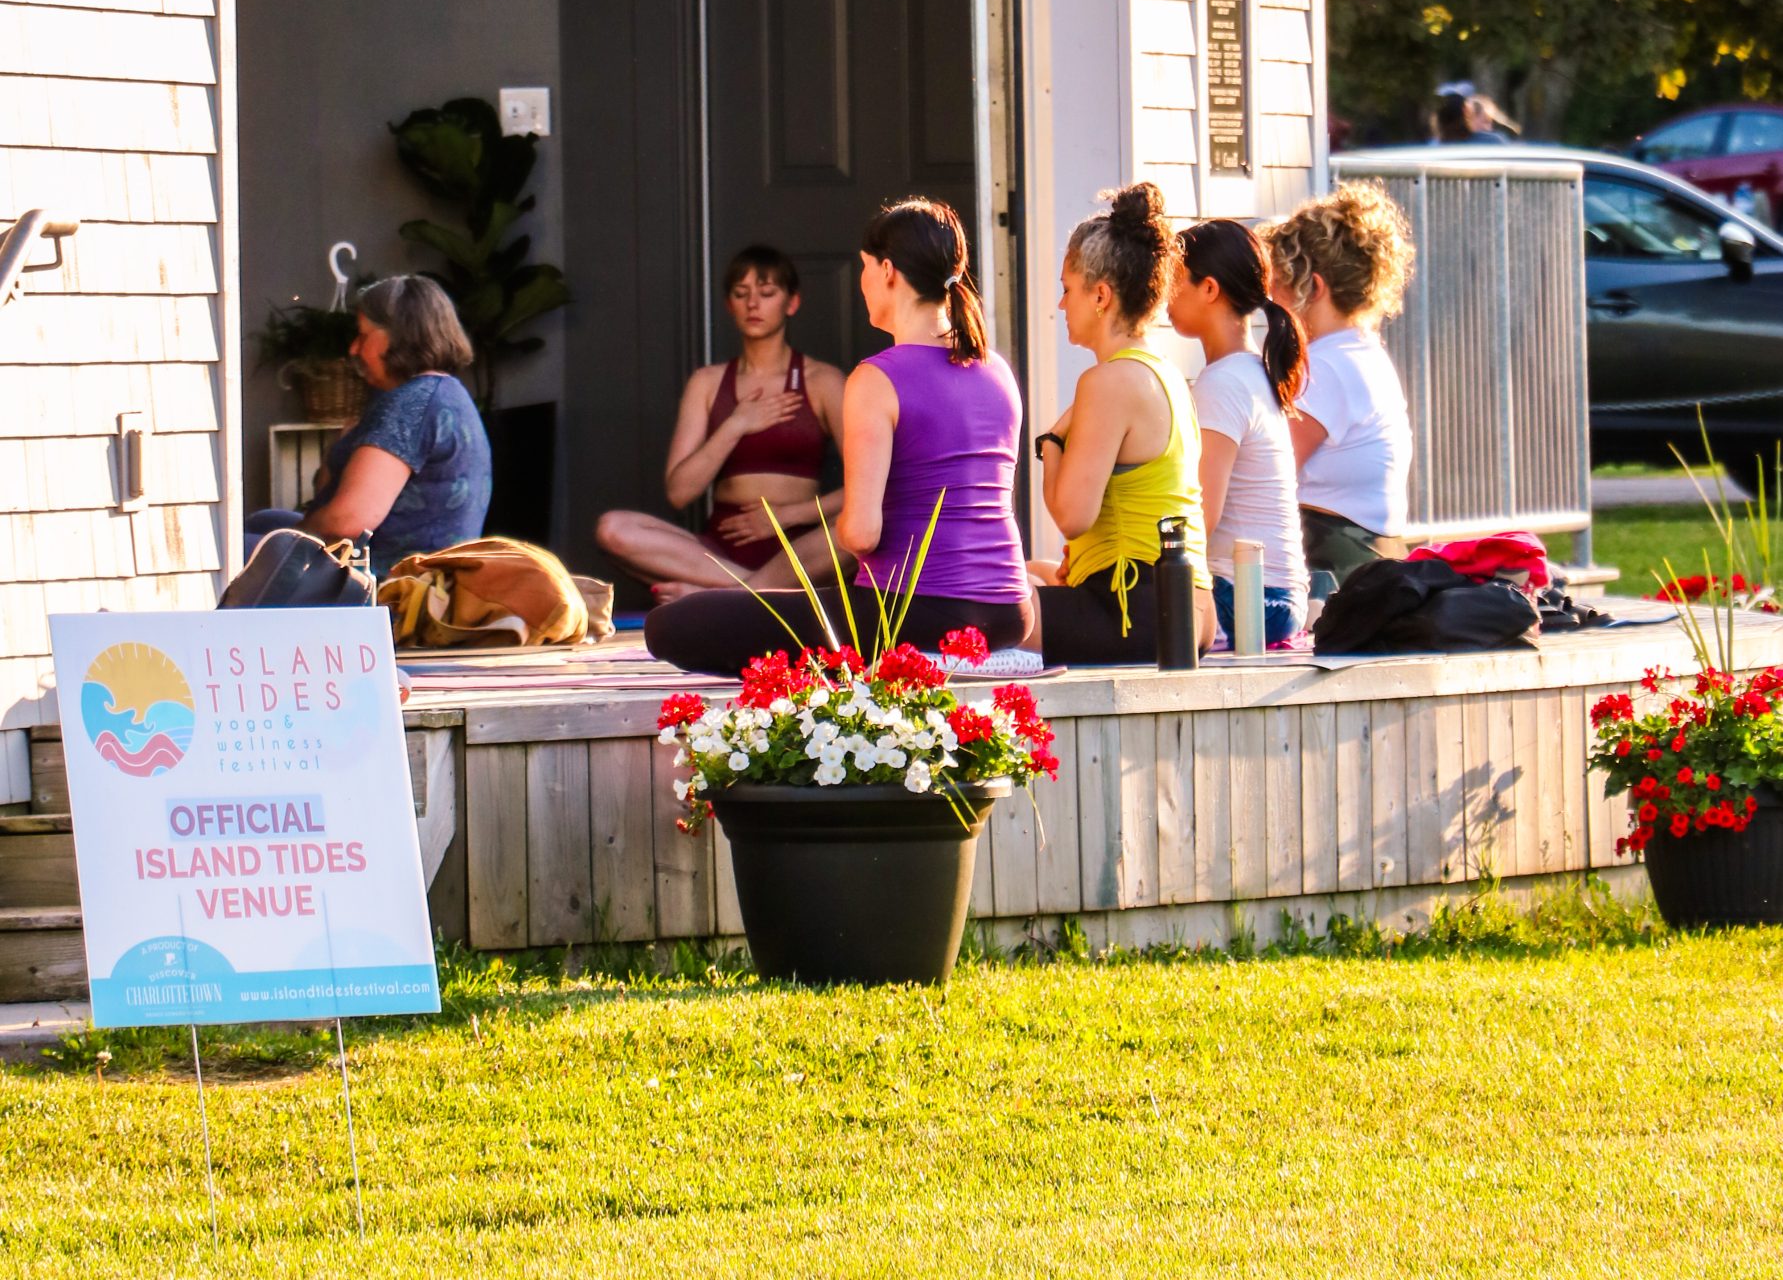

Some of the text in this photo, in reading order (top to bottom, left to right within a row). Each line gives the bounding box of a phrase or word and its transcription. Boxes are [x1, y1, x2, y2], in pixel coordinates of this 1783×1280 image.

[206, 645, 376, 676] ISLAND
[206, 681, 341, 713] TIDES
[215, 714, 293, 733] yoga &
[217, 736, 322, 751] wellness
[219, 755, 320, 772] festival
[170, 802, 325, 836] OFFICIAL
[135, 842, 367, 880] ISLAND TIDES
[196, 885, 316, 919] VENUE
[148, 940, 185, 953] PRODUCT
[187, 943, 198, 952] OF
[149, 969, 197, 982] DISCOVER
[126, 984, 222, 1006] CHARLOTTETOWN
[240, 981, 430, 1002] www.islandtidesfestival.com
